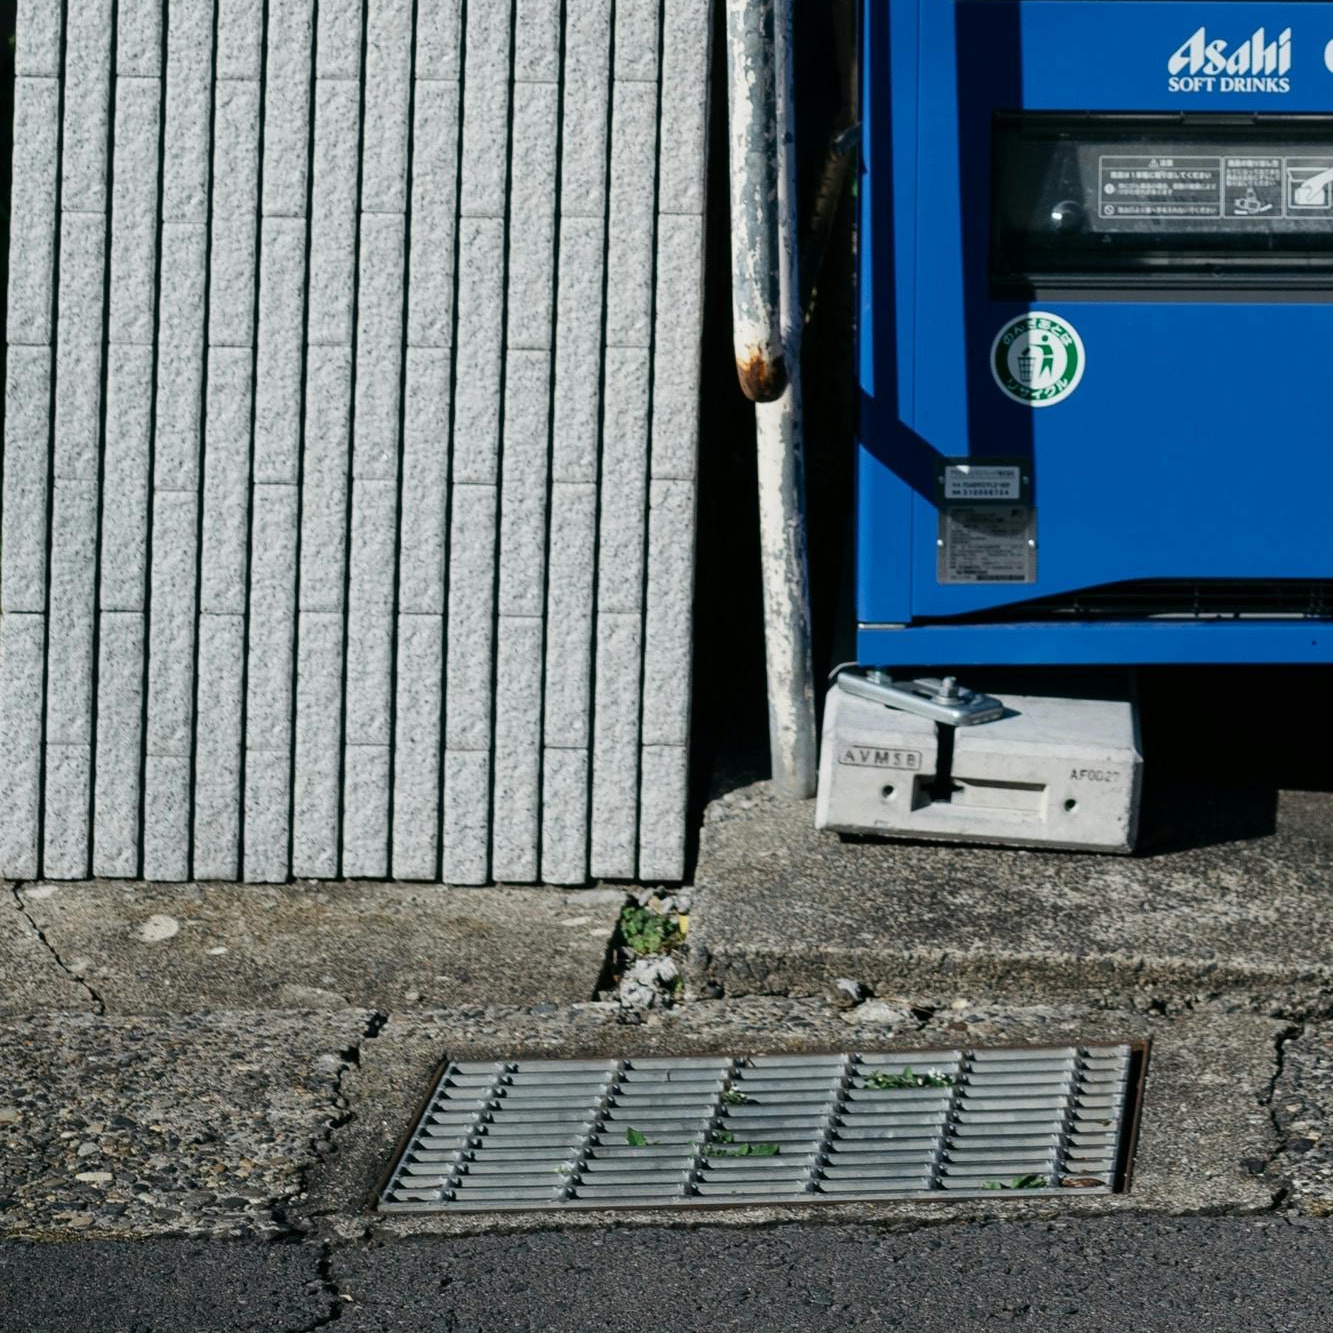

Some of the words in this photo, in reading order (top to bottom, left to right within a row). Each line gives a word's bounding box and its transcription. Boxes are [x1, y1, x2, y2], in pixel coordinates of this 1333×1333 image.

[1168, 26, 1292, 76] Asahi
[1168, 77, 1216, 93] SOFT
[1219, 77, 1291, 93] DRINKS
[1006, 377, 1069, 400] リサイクル
[843, 748, 916, 767] AVMSB
